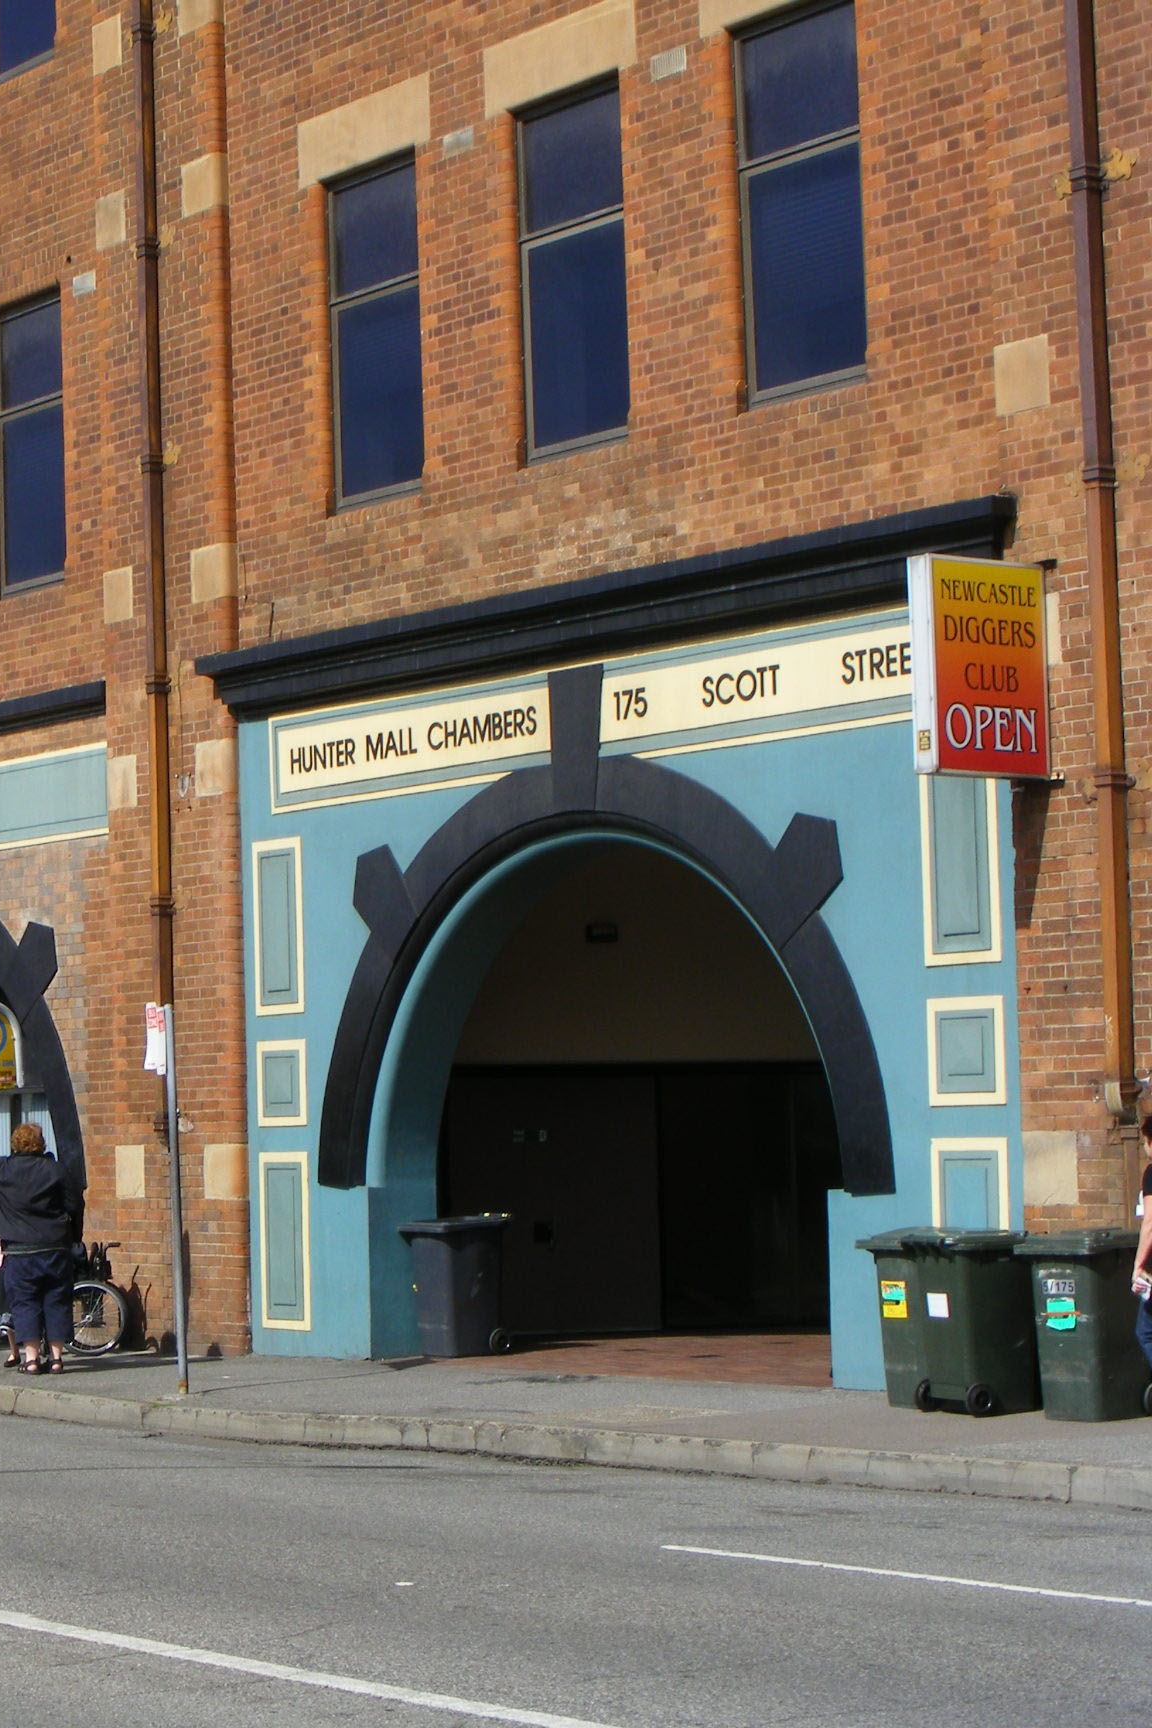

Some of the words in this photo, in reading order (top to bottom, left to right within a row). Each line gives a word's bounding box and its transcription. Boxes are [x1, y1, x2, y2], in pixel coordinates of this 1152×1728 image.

[940, 578, 1037, 608] NEWCASTLE
[943, 615, 1036, 649] DIGGERS
[964, 662, 1019, 692] CLUB
[290, 738, 356, 775] HUNTER
[365, 727, 418, 762] MALL
[427, 705, 537, 750] CHAMBERS
[613, 687, 648, 721] 175
[702, 664, 780, 708] SCOTT
[841, 641, 911, 685] STREE
[945, 702, 1038, 753] OPEN
